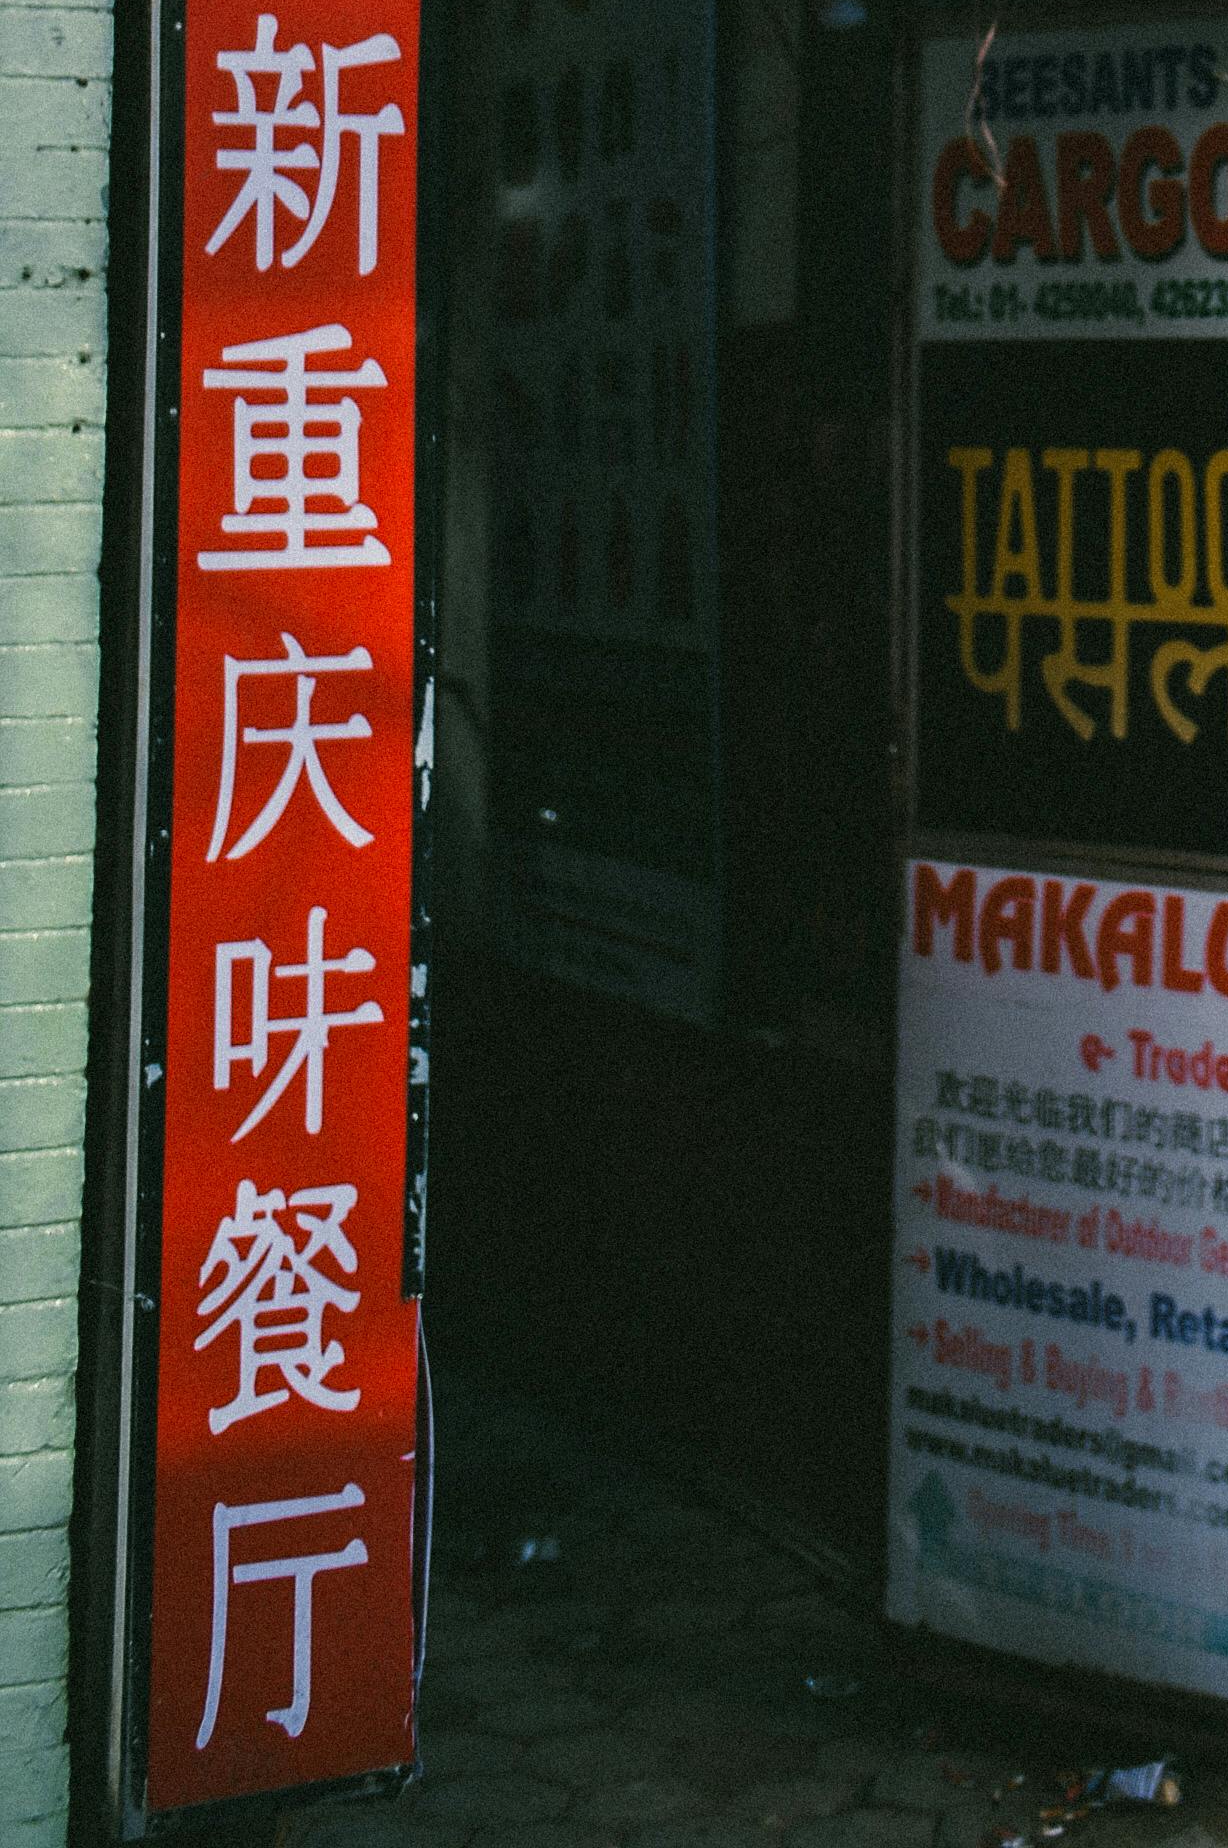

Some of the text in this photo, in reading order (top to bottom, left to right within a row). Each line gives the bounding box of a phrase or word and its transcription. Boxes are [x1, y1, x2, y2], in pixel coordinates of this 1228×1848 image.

[975, 43, 1220, 120] BEESANTS
[194, 13, 405, 1750] 新重庆味餐厅
[934, 1245, 1137, 1344] Wholesale,
